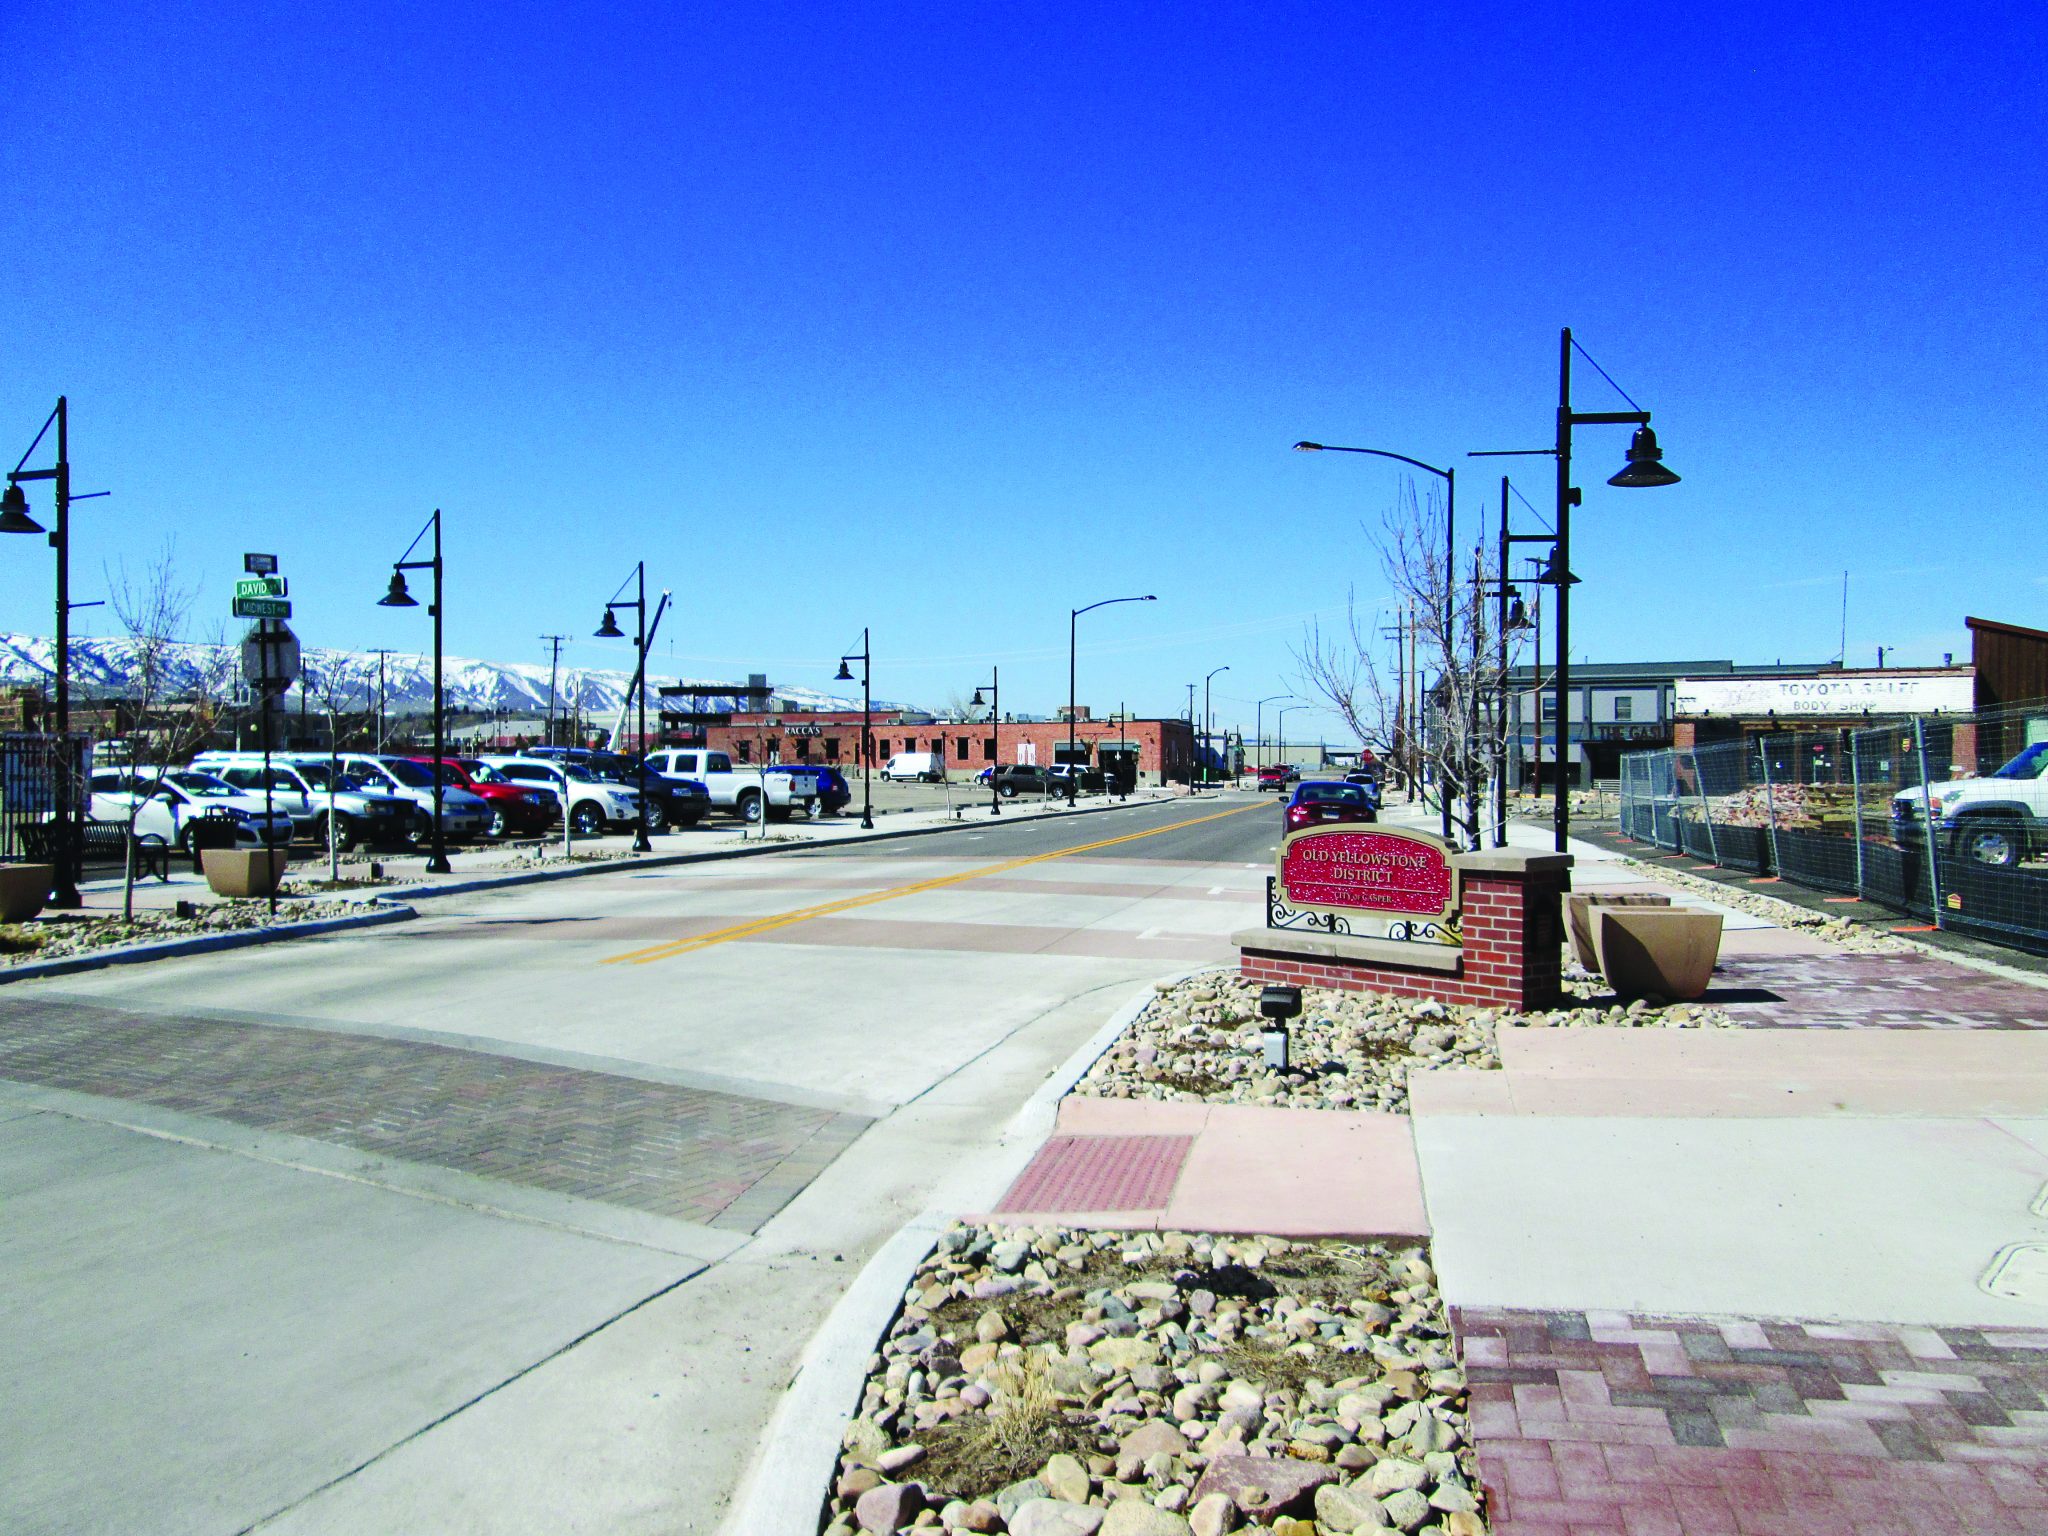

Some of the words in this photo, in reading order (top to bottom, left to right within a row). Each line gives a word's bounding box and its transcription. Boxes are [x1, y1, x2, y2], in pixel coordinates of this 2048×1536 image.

[241, 582, 267, 595] DAVID
[242, 601, 276, 614] MIDWEST
[1778, 682, 1853, 696] TOYOTA
[1793, 700, 1830, 711] BODY
[1839, 700, 1877, 711] SHOP
[784, 727, 820, 735] RACCA'S
[1598, 726, 1625, 740] THE
[1302, 849, 1329, 862] OLD
[1332, 851, 1427, 868] YELLOWSTONE
[1333, 868, 1392, 883] DISTRICT
[1334, 891, 1351, 900] CITY
